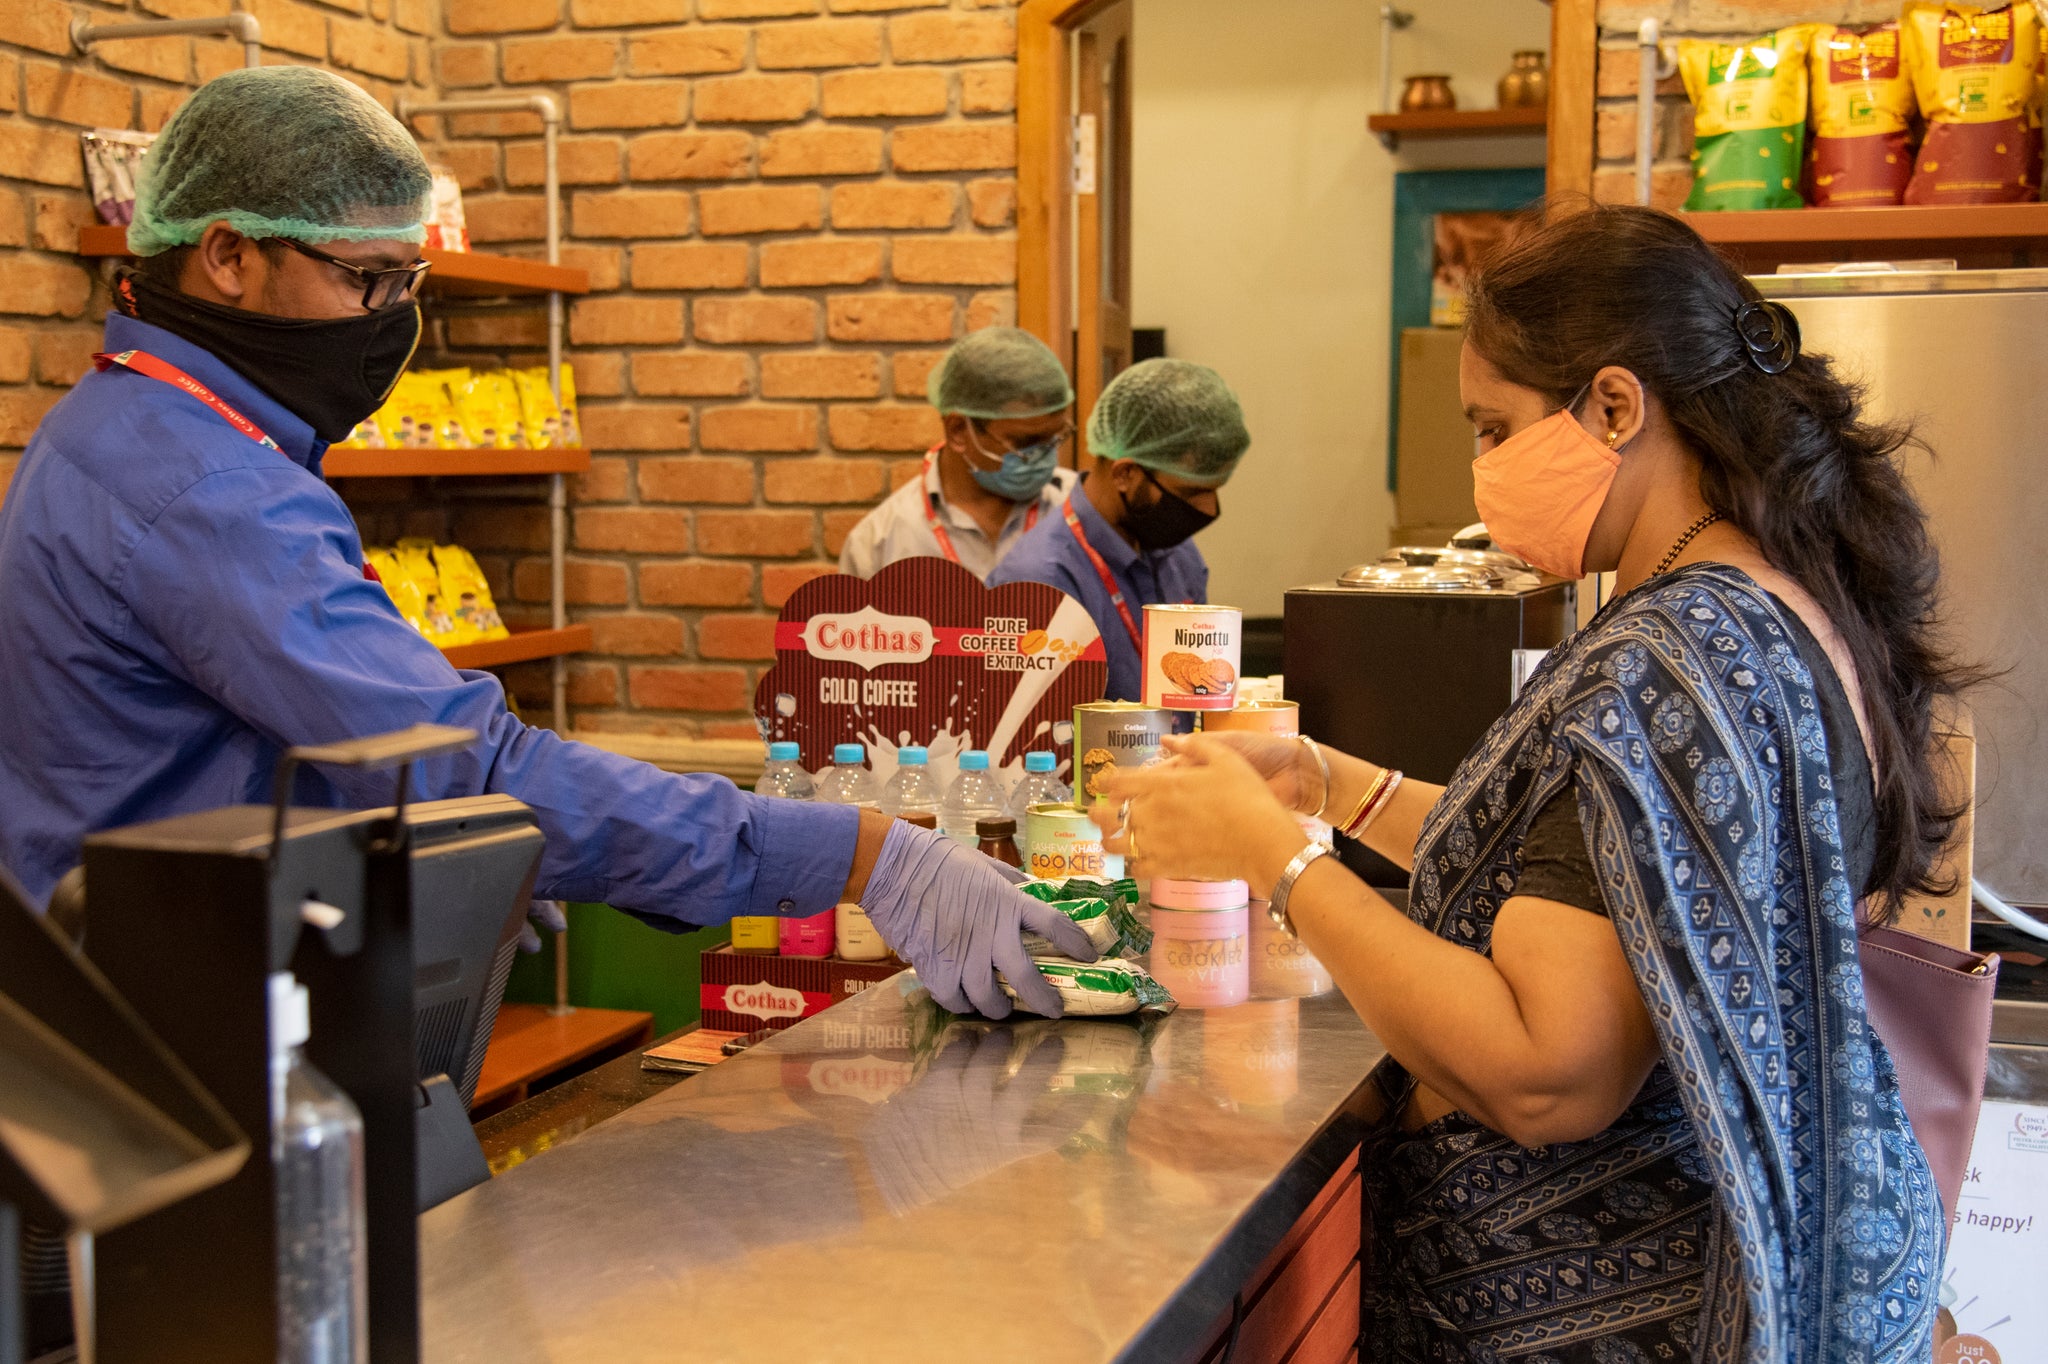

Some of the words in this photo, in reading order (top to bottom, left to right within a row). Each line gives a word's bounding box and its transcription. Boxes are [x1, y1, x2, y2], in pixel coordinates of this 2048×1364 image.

[985, 619, 1027, 634] PURE
[815, 620, 923, 653] Cothas
[961, 636, 1017, 652] COFFEE
[1175, 628, 1229, 648] Nippattu
[986, 655, 1056, 670] EXTRACT
[819, 677, 858, 705] COLD
[863, 679, 918, 707] COFFEE
[1108, 730, 1160, 749] Nippattu
[1031, 841, 1068, 853] CASHEW
[1031, 852, 1106, 872] COOKIES
[844, 979, 864, 993] COLD
[733, 989, 799, 1012] Cothas
[1967, 1209, 2033, 1234] happy!
[1956, 1342, 1984, 1357] Just
